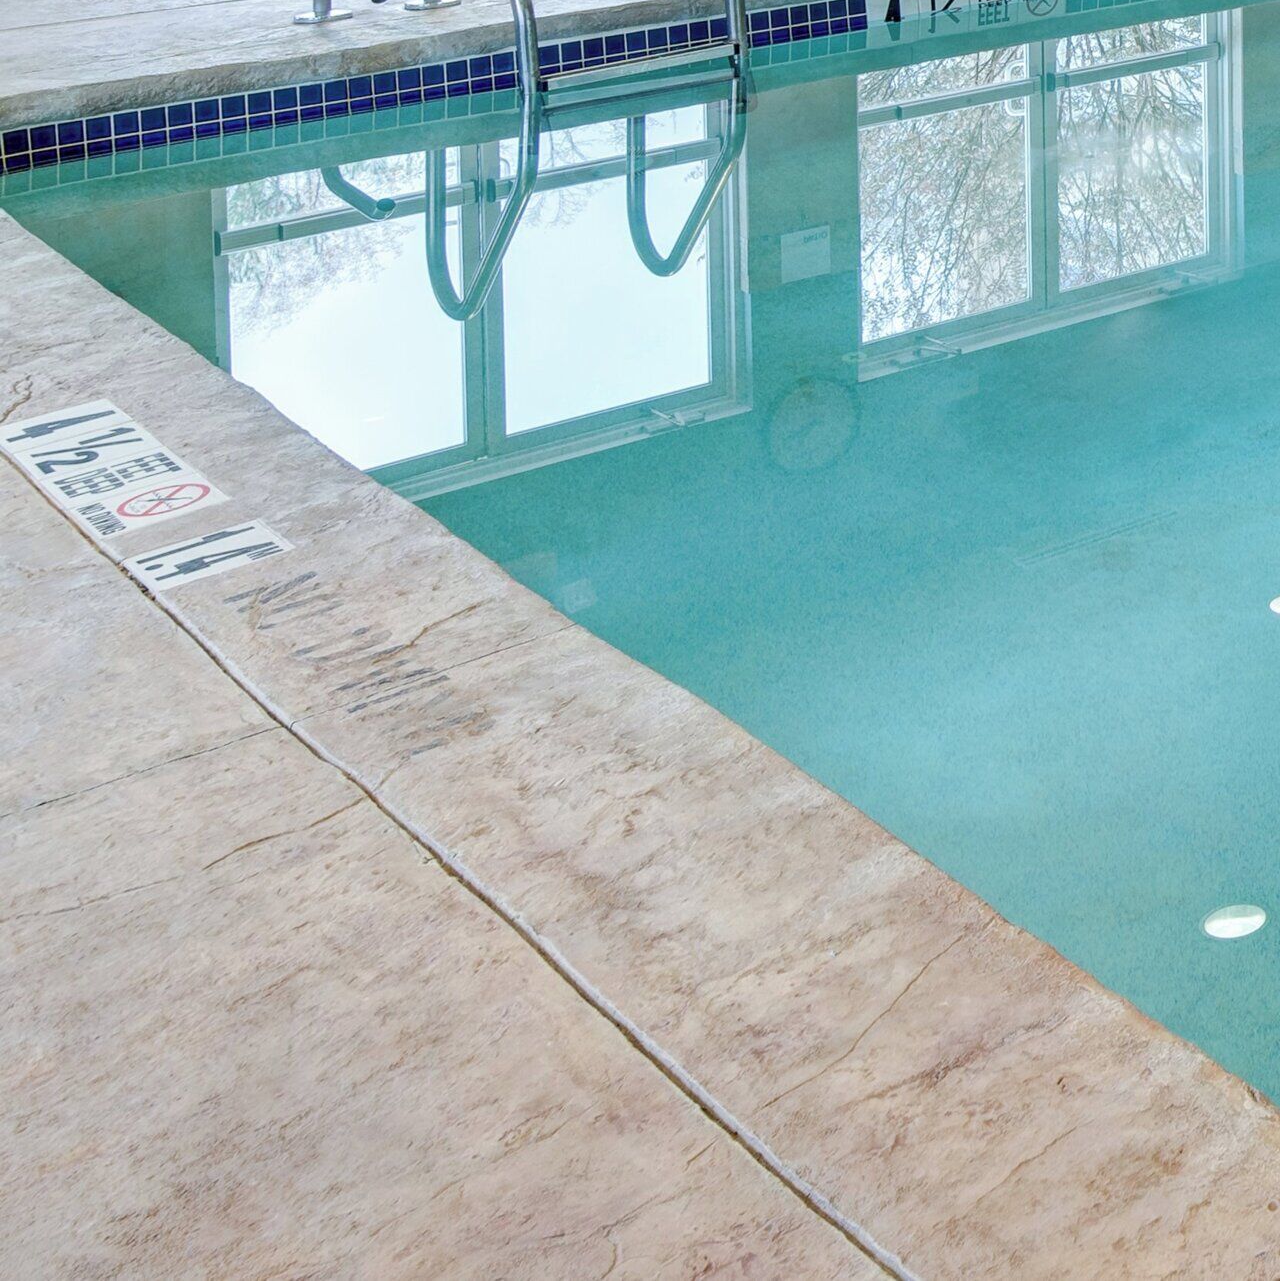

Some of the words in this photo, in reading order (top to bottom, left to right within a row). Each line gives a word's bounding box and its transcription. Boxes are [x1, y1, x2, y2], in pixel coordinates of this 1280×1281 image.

[6, 410, 116, 442] 4
[30, 427, 143, 475] 1/2
[110, 452, 182, 483] FEET
[54, 468, 125, 499] DEEP
[77, 502, 106, 515] NO
[85, 511, 126, 536] DIVING
